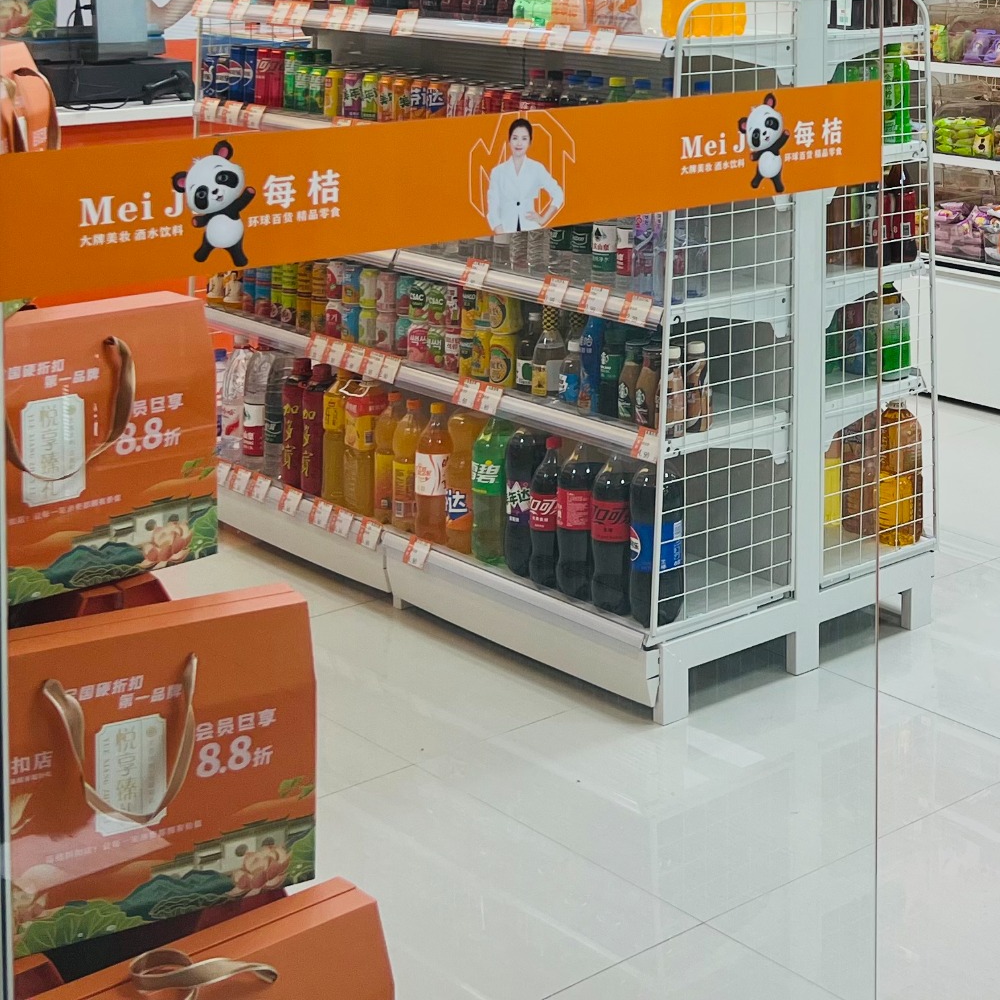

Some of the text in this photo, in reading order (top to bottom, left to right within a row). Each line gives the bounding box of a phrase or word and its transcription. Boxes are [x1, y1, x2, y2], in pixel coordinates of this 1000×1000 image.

[680, 132, 727, 160] Mei
[794, 117, 842, 147] 每桔
[80, 191, 153, 227] Mei
[264, 169, 340, 209] 每桔
[80, 207, 341, 247] 大牌美妆 酒水饮料 环球百货 精品零食
[44, 367, 100, 389] 第一品牌
[115, 416, 182, 457] 8.8折
[446, 489, 468, 513] 达
[118, 683, 183, 709] 第一品牌
[11, 750, 53, 775] 扣店
[196, 735, 273, 777] 8.8折
